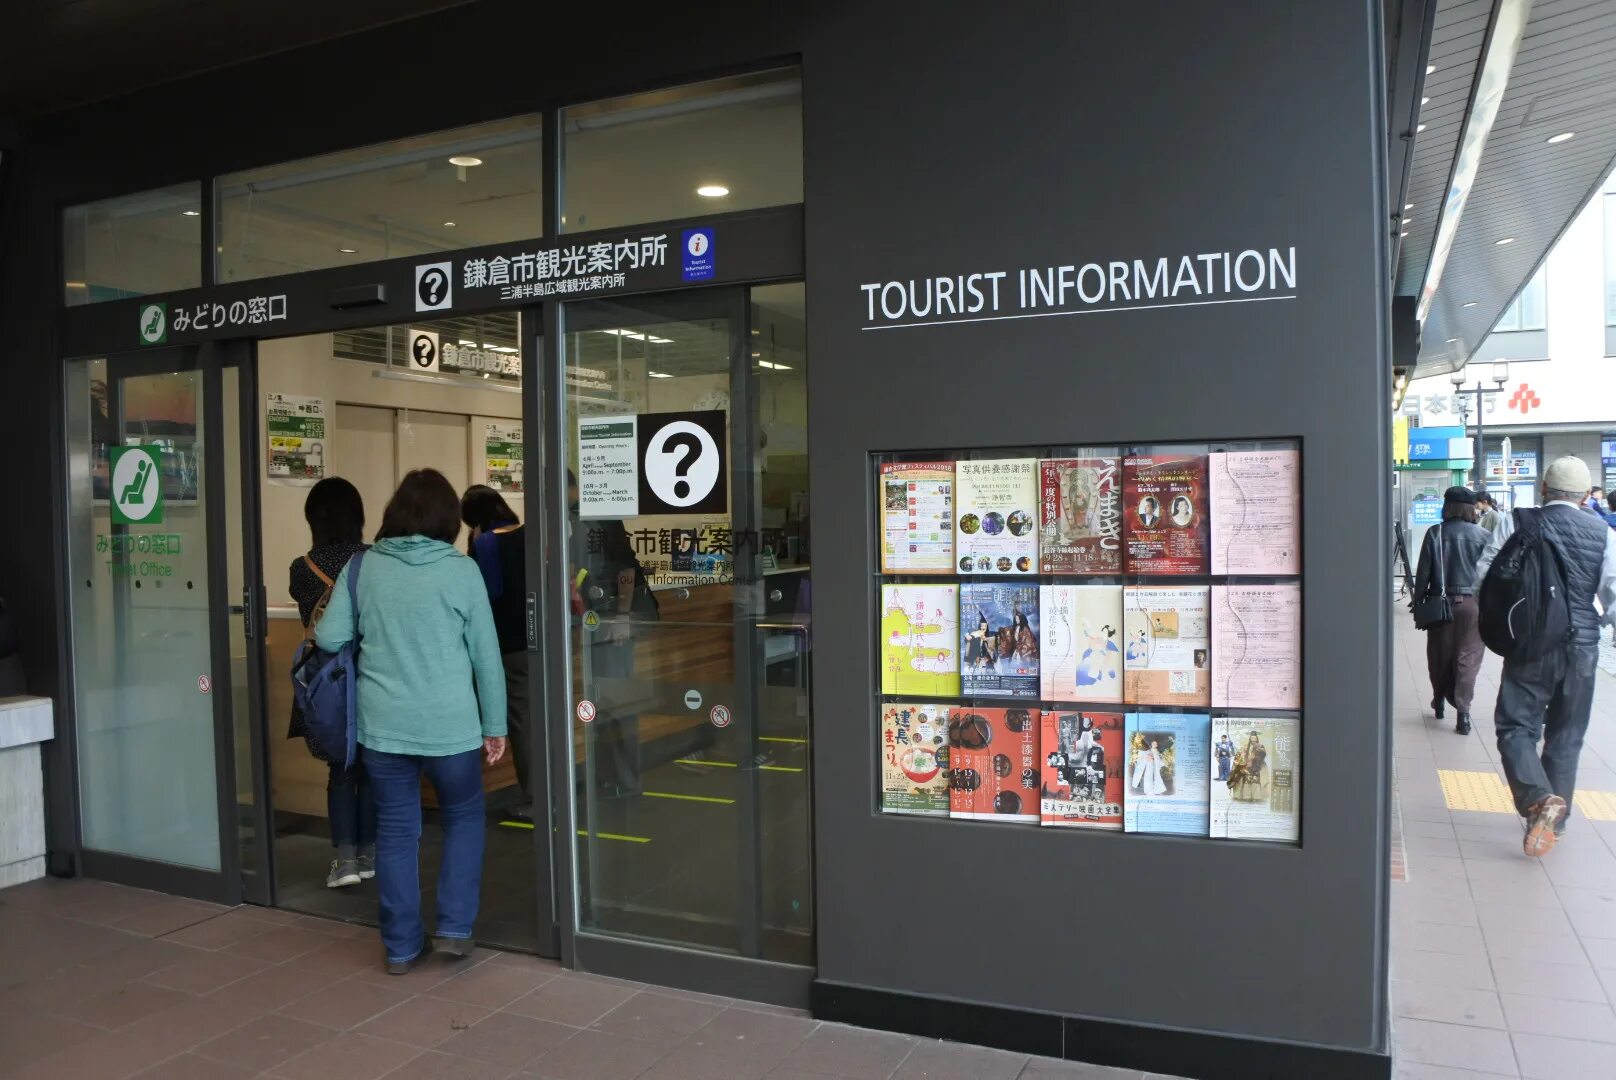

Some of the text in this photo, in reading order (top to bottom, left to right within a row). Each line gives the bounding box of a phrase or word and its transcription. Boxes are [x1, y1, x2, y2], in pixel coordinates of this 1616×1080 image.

[463, 234, 668, 290] 鎌倉市観光案内所
[500, 273, 626, 301] 三浦半島広域観光案内所
[860, 246, 1296, 321] TOURIST INFORMATION
[173, 294, 287, 331] みどりの窓口
[603, 462, 631, 471] September
[582, 489, 603, 497] October
[139, 560, 172, 577] Office
[653, 572, 716, 587] Information
[895, 710, 911, 746] 建長
[885, 729, 897, 764] まつり
[1022, 719, 1033, 790] 出土漆器の美
[1043, 802, 1121, 815] ミステリー映画大全集
